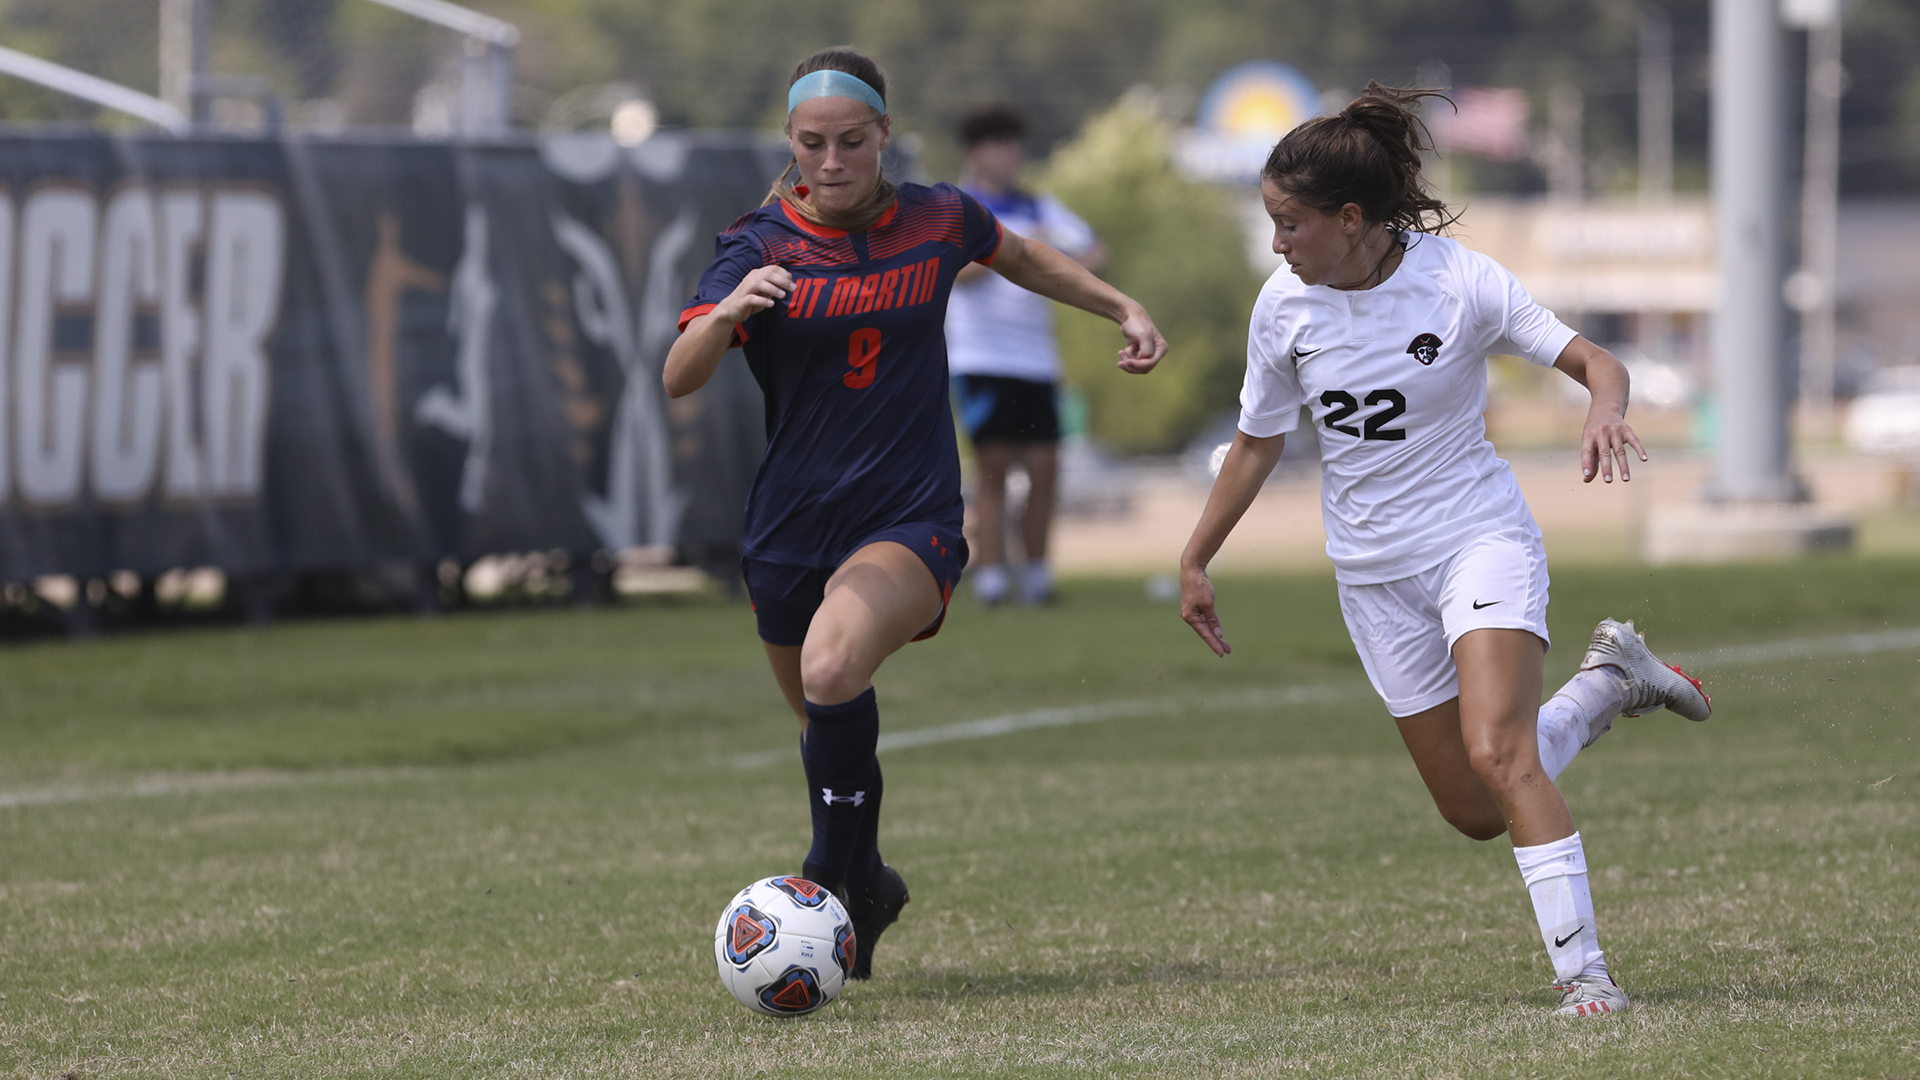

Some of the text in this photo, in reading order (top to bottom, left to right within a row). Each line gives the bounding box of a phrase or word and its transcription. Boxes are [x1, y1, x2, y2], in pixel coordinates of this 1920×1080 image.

[787, 257, 940, 319] UT MARTIN
[0, 184, 285, 503] CCER
[842, 327, 882, 389] 9
[1320, 389, 1406, 441] 22
